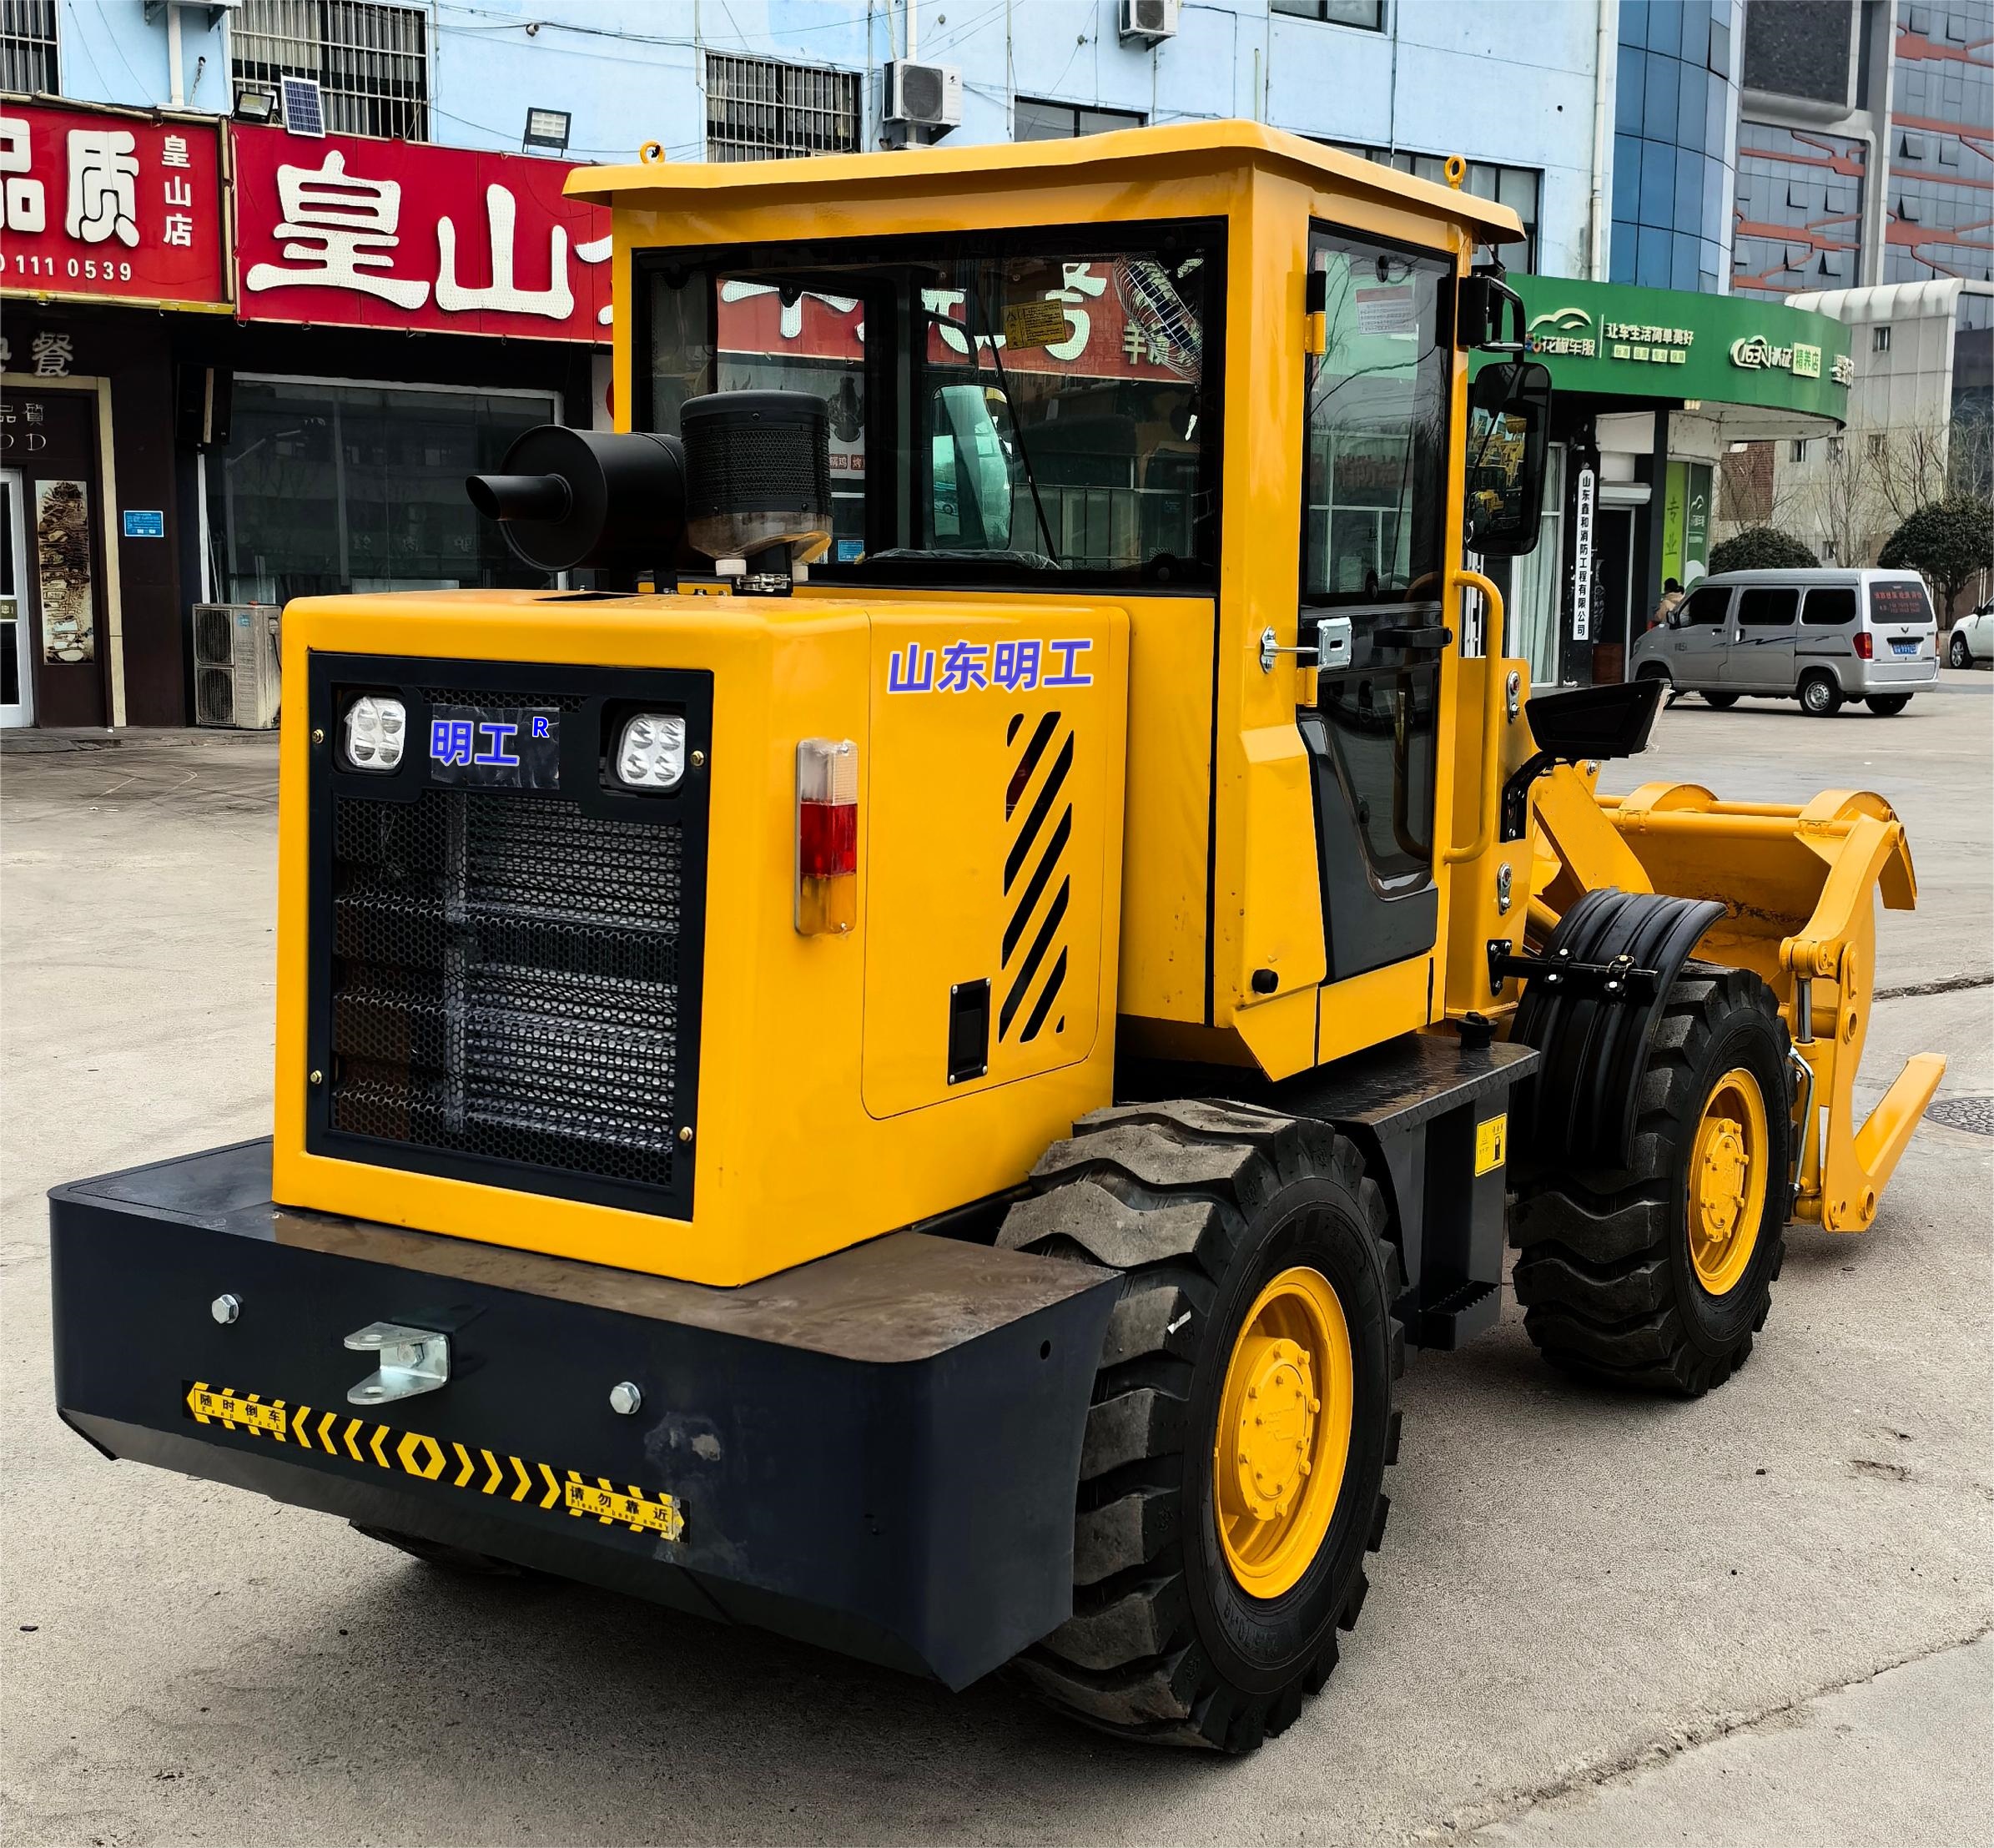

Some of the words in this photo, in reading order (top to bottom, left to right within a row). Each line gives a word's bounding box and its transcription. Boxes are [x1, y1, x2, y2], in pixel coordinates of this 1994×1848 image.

[161, 135, 193, 247] 皇山店
[246, 149, 613, 320] 皇山
[16, 255, 54, 276] 111
[67, 259, 132, 281] 0539
[200, 1393, 281, 1423] 随时倒车
[571, 1486, 668, 1523] 请勿靠近
